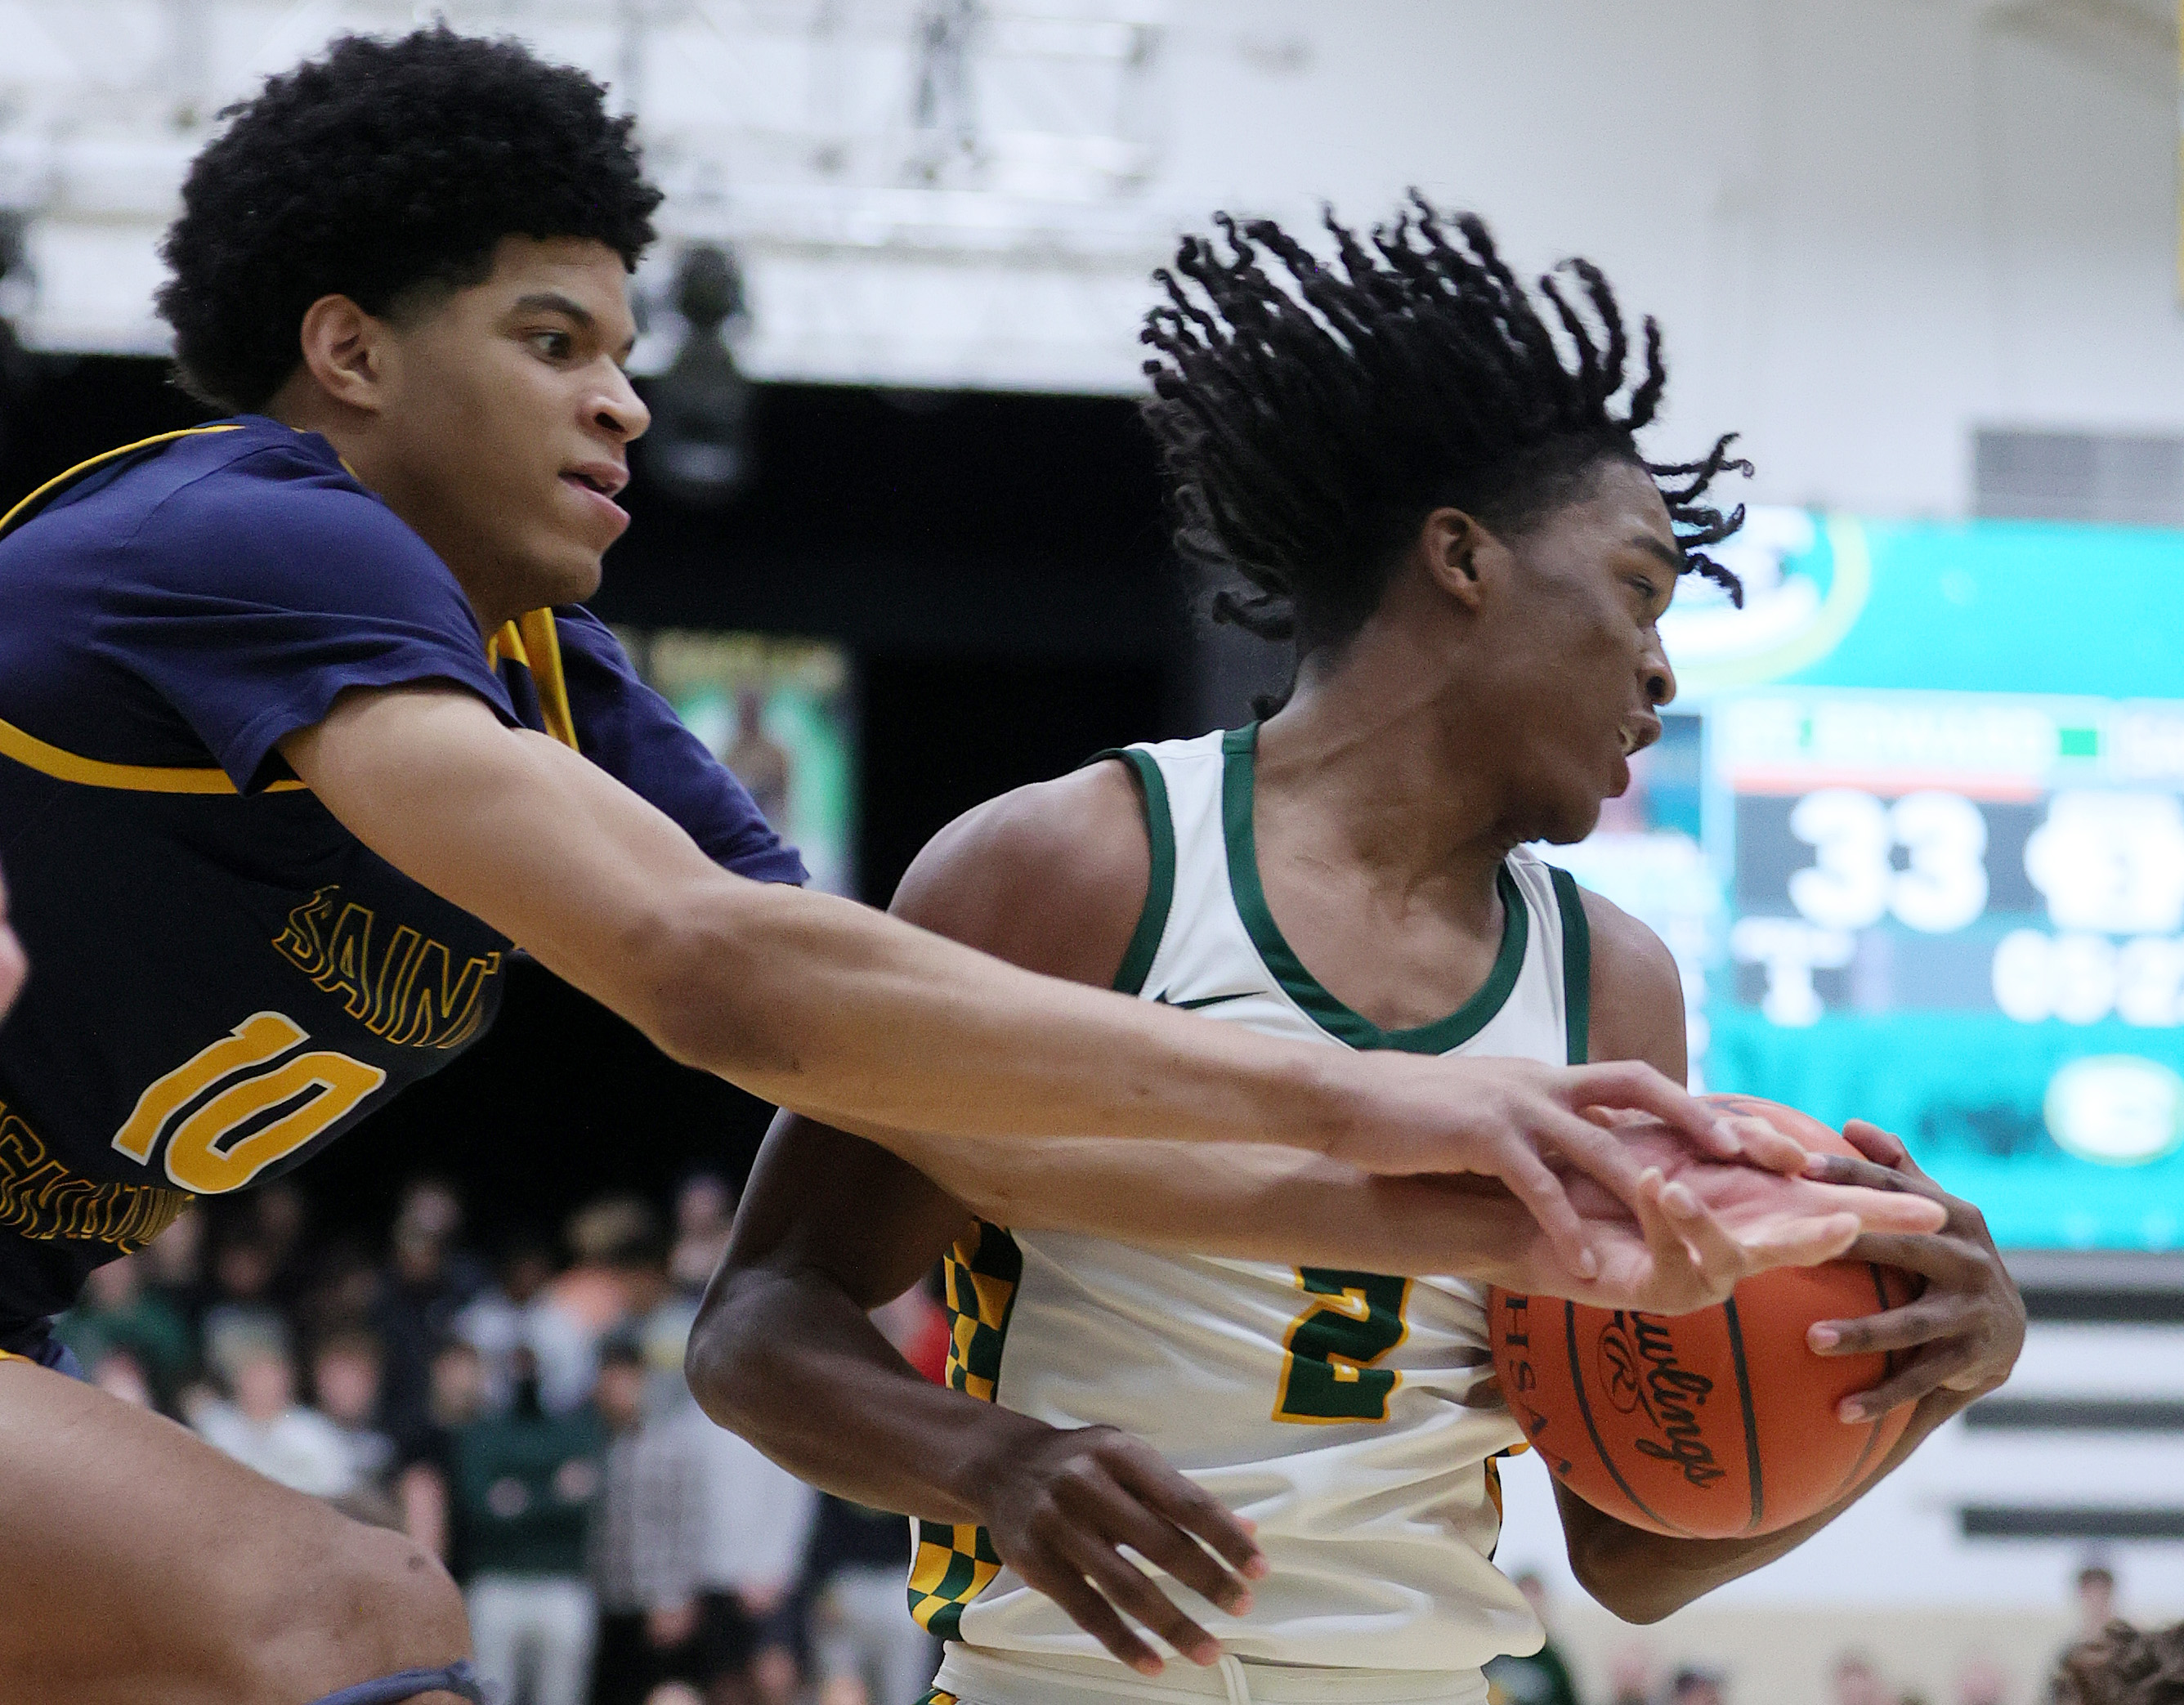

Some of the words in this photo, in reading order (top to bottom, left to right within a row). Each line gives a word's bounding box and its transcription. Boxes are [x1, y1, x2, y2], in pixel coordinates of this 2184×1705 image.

[1790, 790, 1987, 932] 33
[271, 884, 501, 1049] SAIN
[111, 1010, 387, 1195] 10
[1271, 1266, 1414, 1425] 2
[1630, 1310, 1725, 1489] wlings
